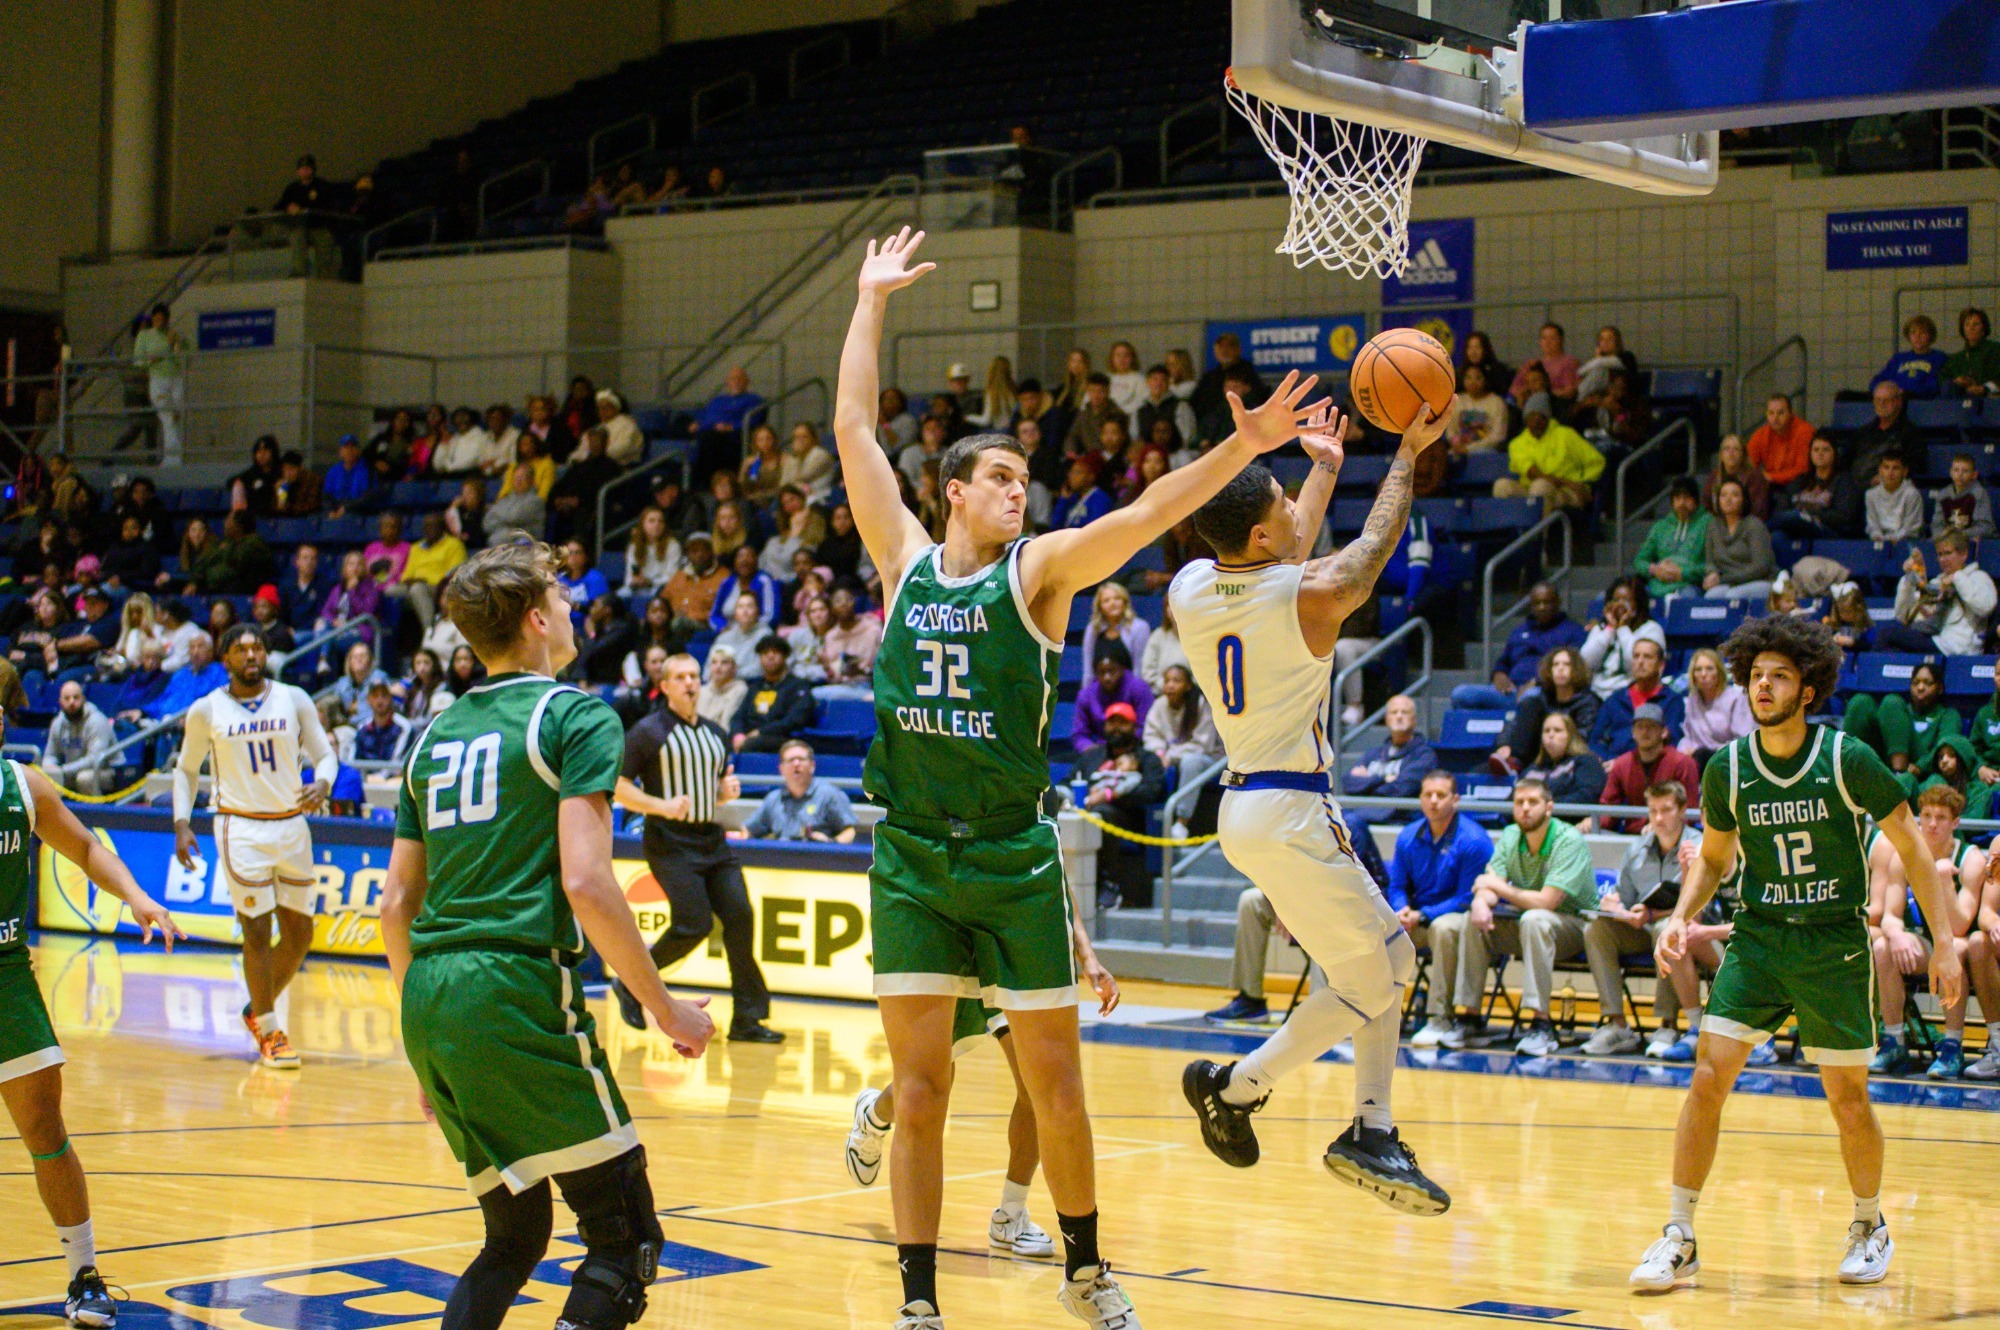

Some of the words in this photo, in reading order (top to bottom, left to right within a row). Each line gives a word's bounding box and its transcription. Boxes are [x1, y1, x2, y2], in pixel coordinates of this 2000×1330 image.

[1831, 222, 1849, 234] NO
[1850, 219, 1910, 233] STANDING
[1913, 219, 1926, 230] IN
[1928, 217, 1964, 230] AISLE
[1862, 245, 1903, 259] THANK
[1906, 244, 1932, 257] YOU
[1400, 269, 1458, 285] adidas
[1215, 583, 1246, 596] PBC
[915, 639, 971, 700] 32
[1217, 633, 1246, 716] 0
[228, 718, 287, 737] LANDER
[896, 706, 997, 739] COLLEGE
[246, 738, 277, 774] 14
[427, 731, 502, 831] 20
[1748, 798, 1829, 827] GEORGIA
[0, 829, 21, 855] IA
[1773, 831, 1816, 876] 12
[1761, 878, 1840, 905] COLLEGE
